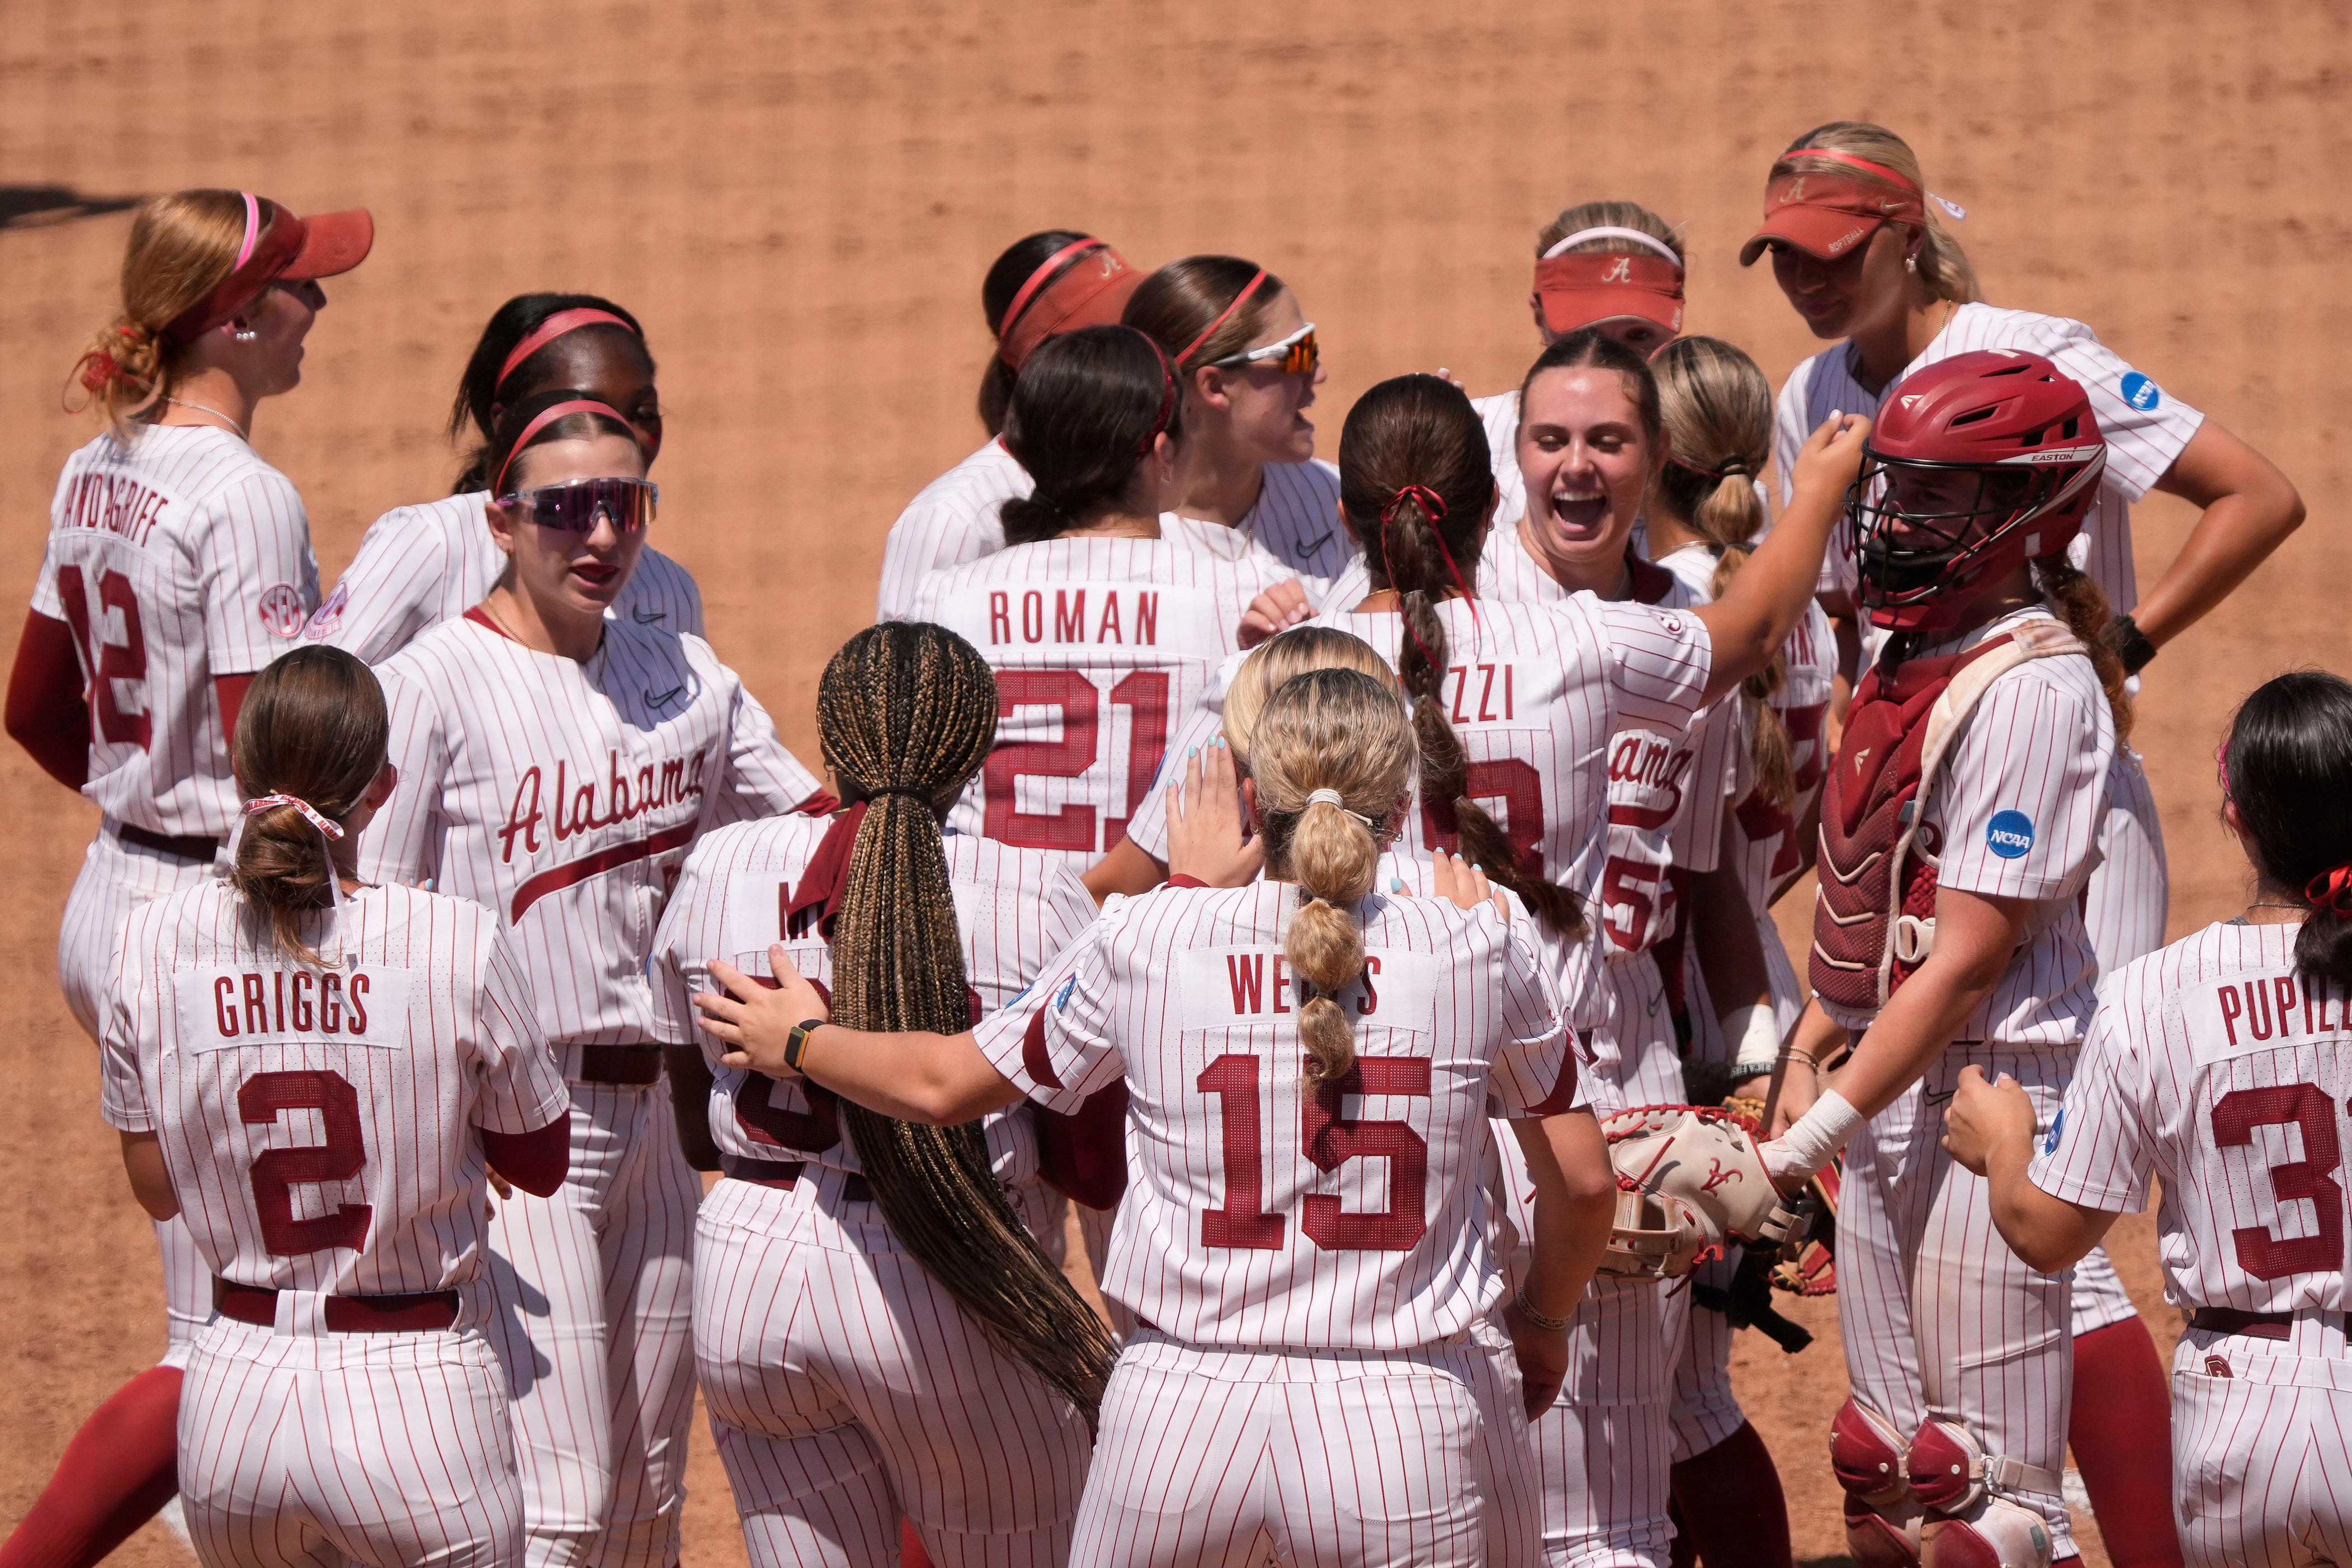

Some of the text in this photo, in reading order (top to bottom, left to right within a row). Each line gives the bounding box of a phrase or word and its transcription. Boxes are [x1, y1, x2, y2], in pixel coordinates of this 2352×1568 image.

[1827, 225, 1864, 253] SOFTBALL
[2031, 454, 2074, 463] EASTON
[58, 564, 153, 755] 12
[990, 589, 1159, 646] ROMAN
[984, 670, 1170, 852] 21
[497, 749, 706, 863] Alabama
[1990, 829, 2030, 848] NCAA
[214, 972, 370, 1037] GRIGGS
[237, 1070, 372, 1254] 2
[1197, 1054, 1432, 1252] 15
